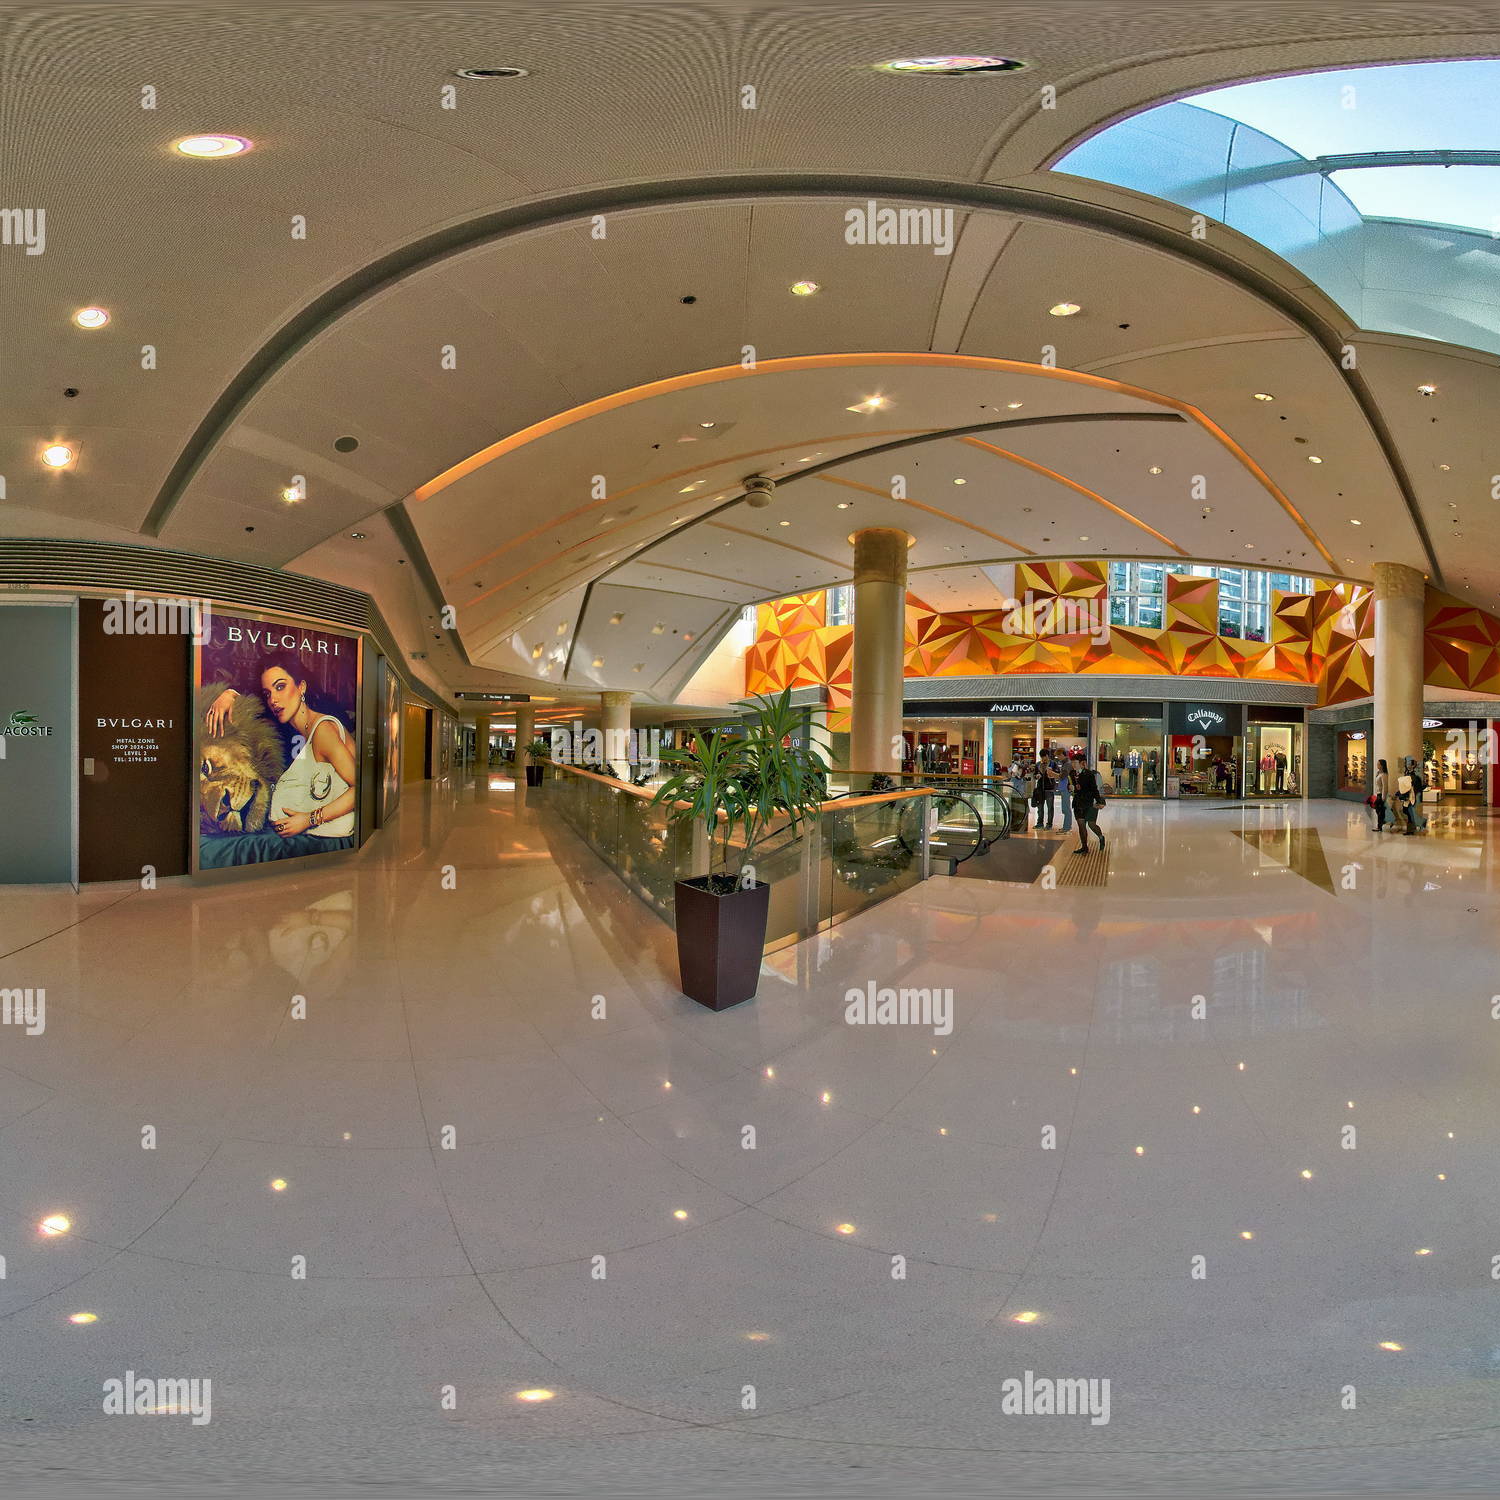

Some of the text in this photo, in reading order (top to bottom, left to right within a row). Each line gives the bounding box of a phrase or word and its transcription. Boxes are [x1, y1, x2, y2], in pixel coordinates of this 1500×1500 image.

[227, 627, 340, 656] BVLGARI
[97, 718, 173, 728] BVLGARI
[1188, 709, 1224, 723] Callaway
